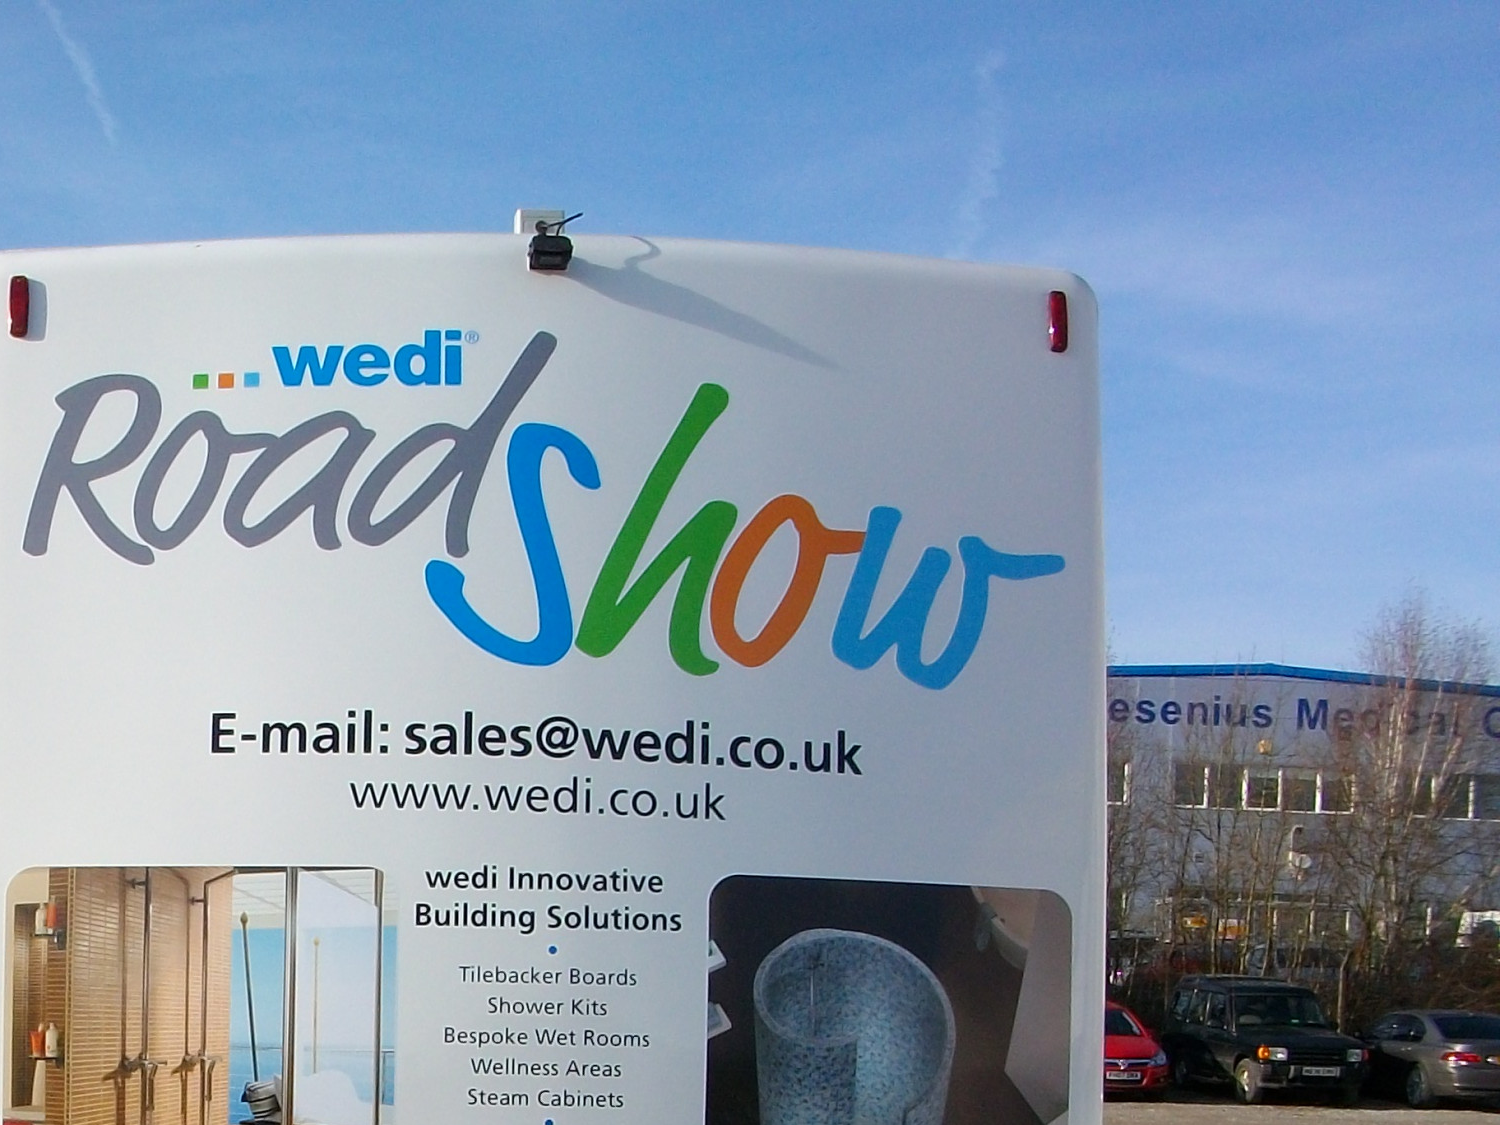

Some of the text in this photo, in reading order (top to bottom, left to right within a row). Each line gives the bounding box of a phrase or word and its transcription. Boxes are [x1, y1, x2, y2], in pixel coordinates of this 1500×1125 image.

[210, 711, 864, 778] E-mail: sales@wedi.co.uk
[350, 777, 727, 822] www.wedi.co.uk
[425, 865, 664, 894] wedi Innovative
[414, 903, 683, 935] Building Solutions
[459, 965, 637, 986] Tilebacker Boards
[487, 997, 608, 1016] Shower Kits
[444, 1027, 650, 1048] Bespoke Wet Rooms
[470, 1058, 622, 1078] Wellness Areas
[467, 1089, 624, 1108] Steam Cabinets
